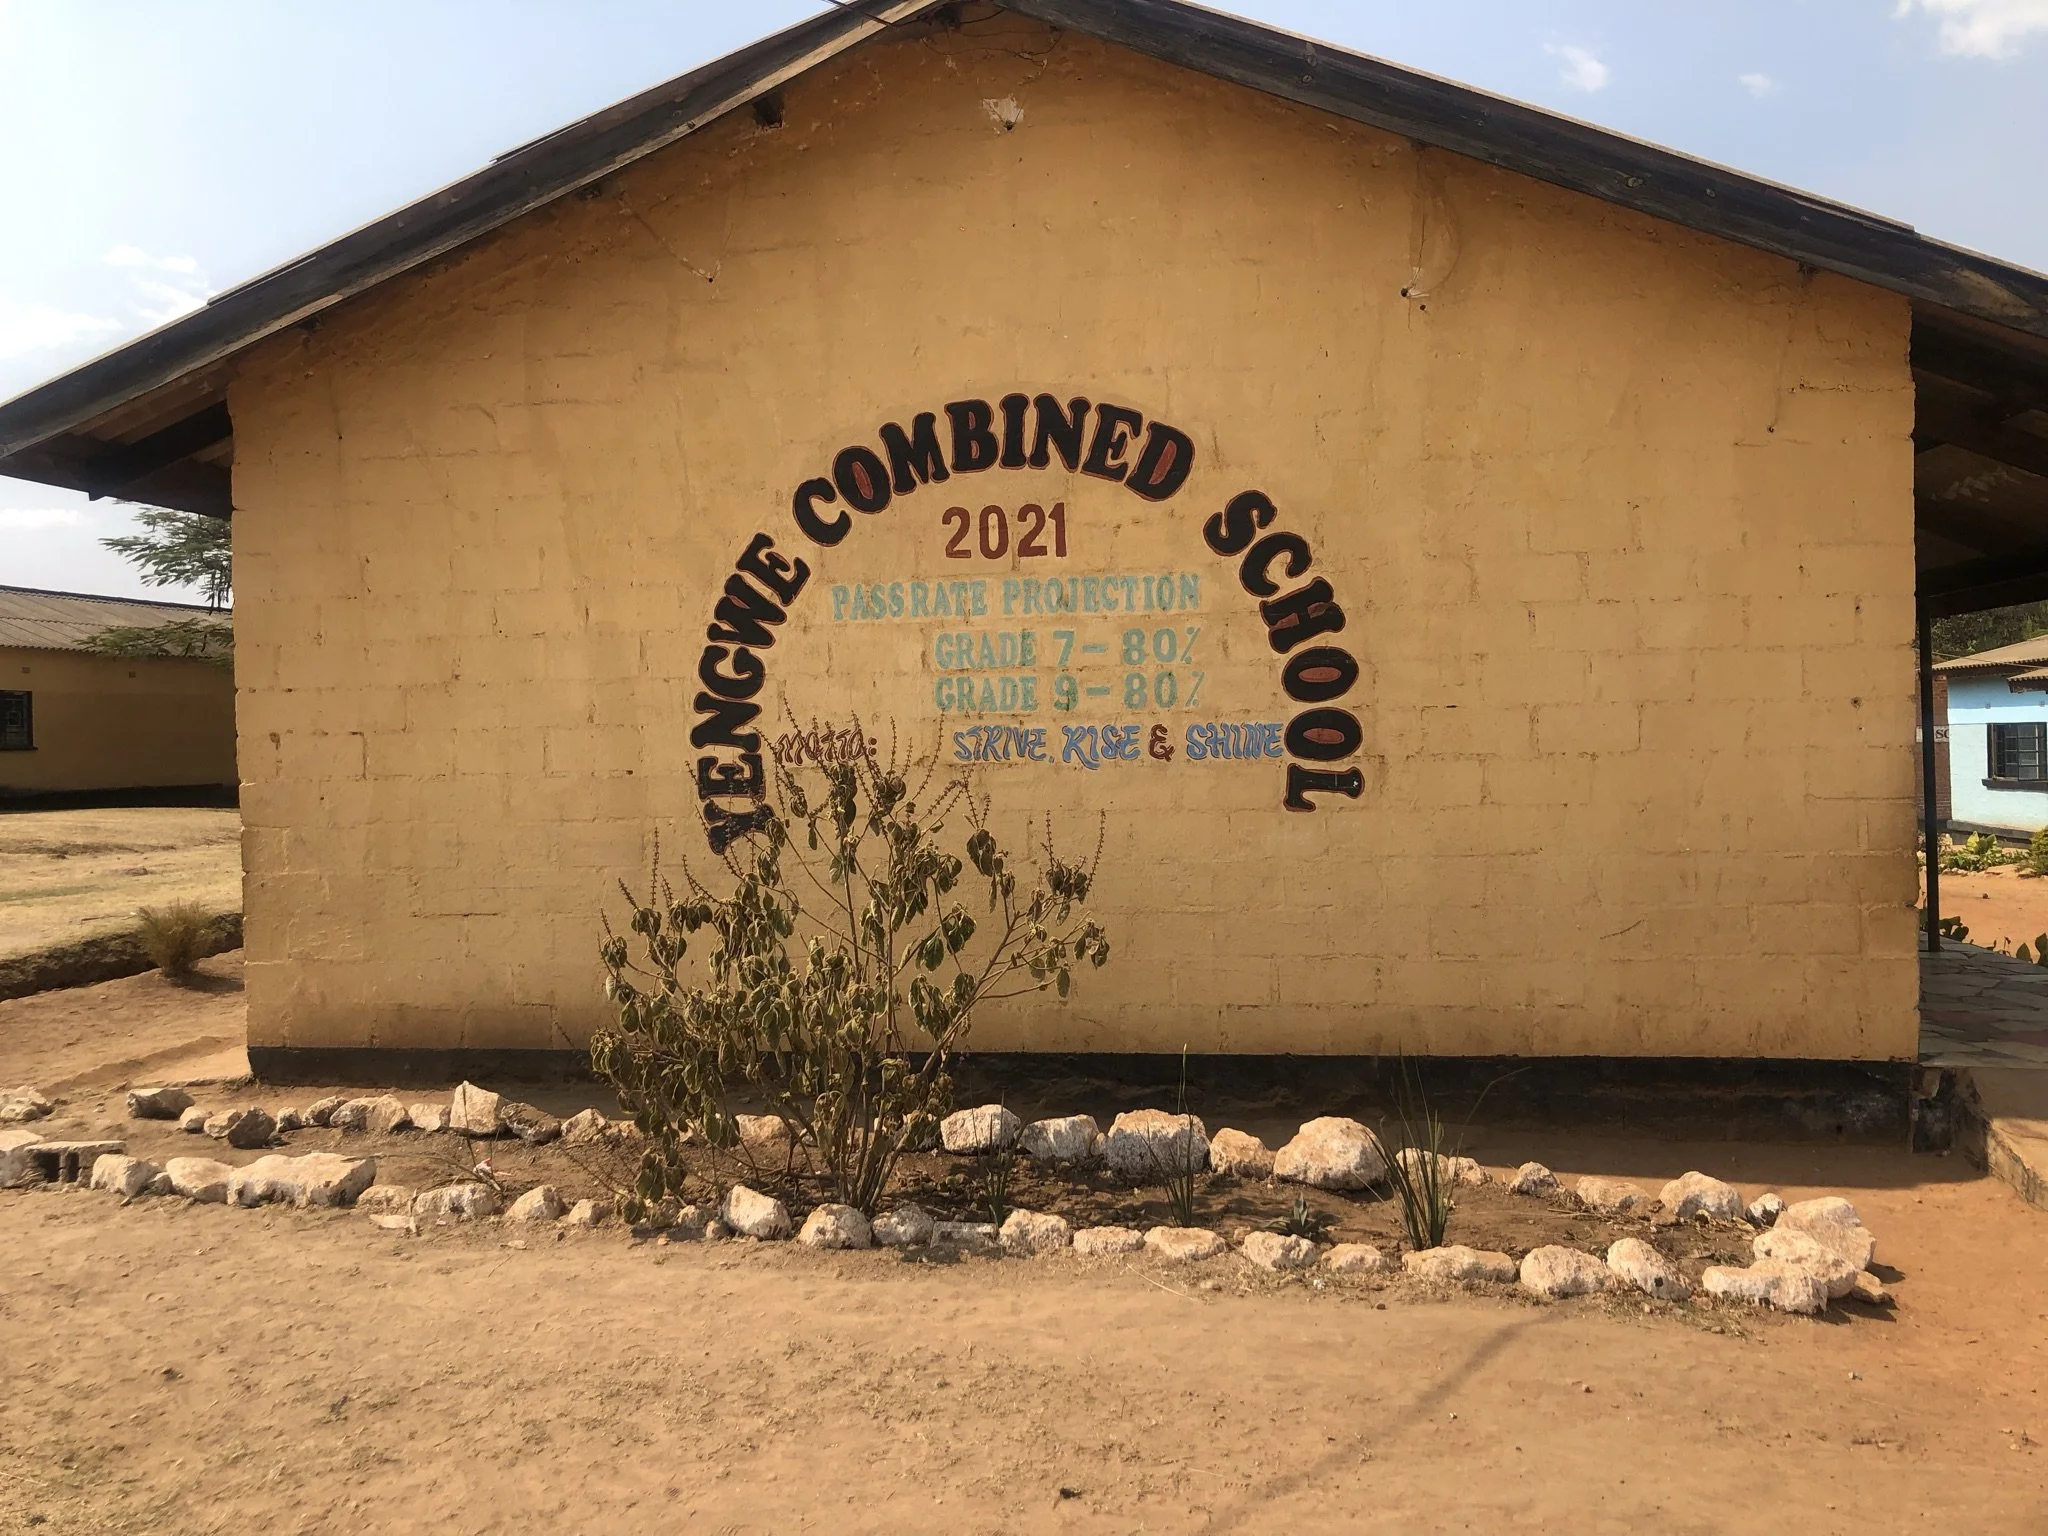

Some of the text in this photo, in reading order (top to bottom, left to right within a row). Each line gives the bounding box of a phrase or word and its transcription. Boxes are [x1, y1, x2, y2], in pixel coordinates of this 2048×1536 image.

[941, 502, 1067, 559] 2021
[792, 393, 1195, 547] COMBINED
[1203, 489, 1365, 813] SCHOOL
[1002, 573, 1200, 614] PROJECTION
[934, 629, 1037, 670] GRADE
[1121, 626, 1200, 667] 80%
[934, 675, 1038, 712] GRADE
[1123, 670, 1205, 710] 80%
[1061, 724, 1142, 770] RISE
[1148, 723, 1175, 762] &
[1186, 722, 1284, 761] SHINE
